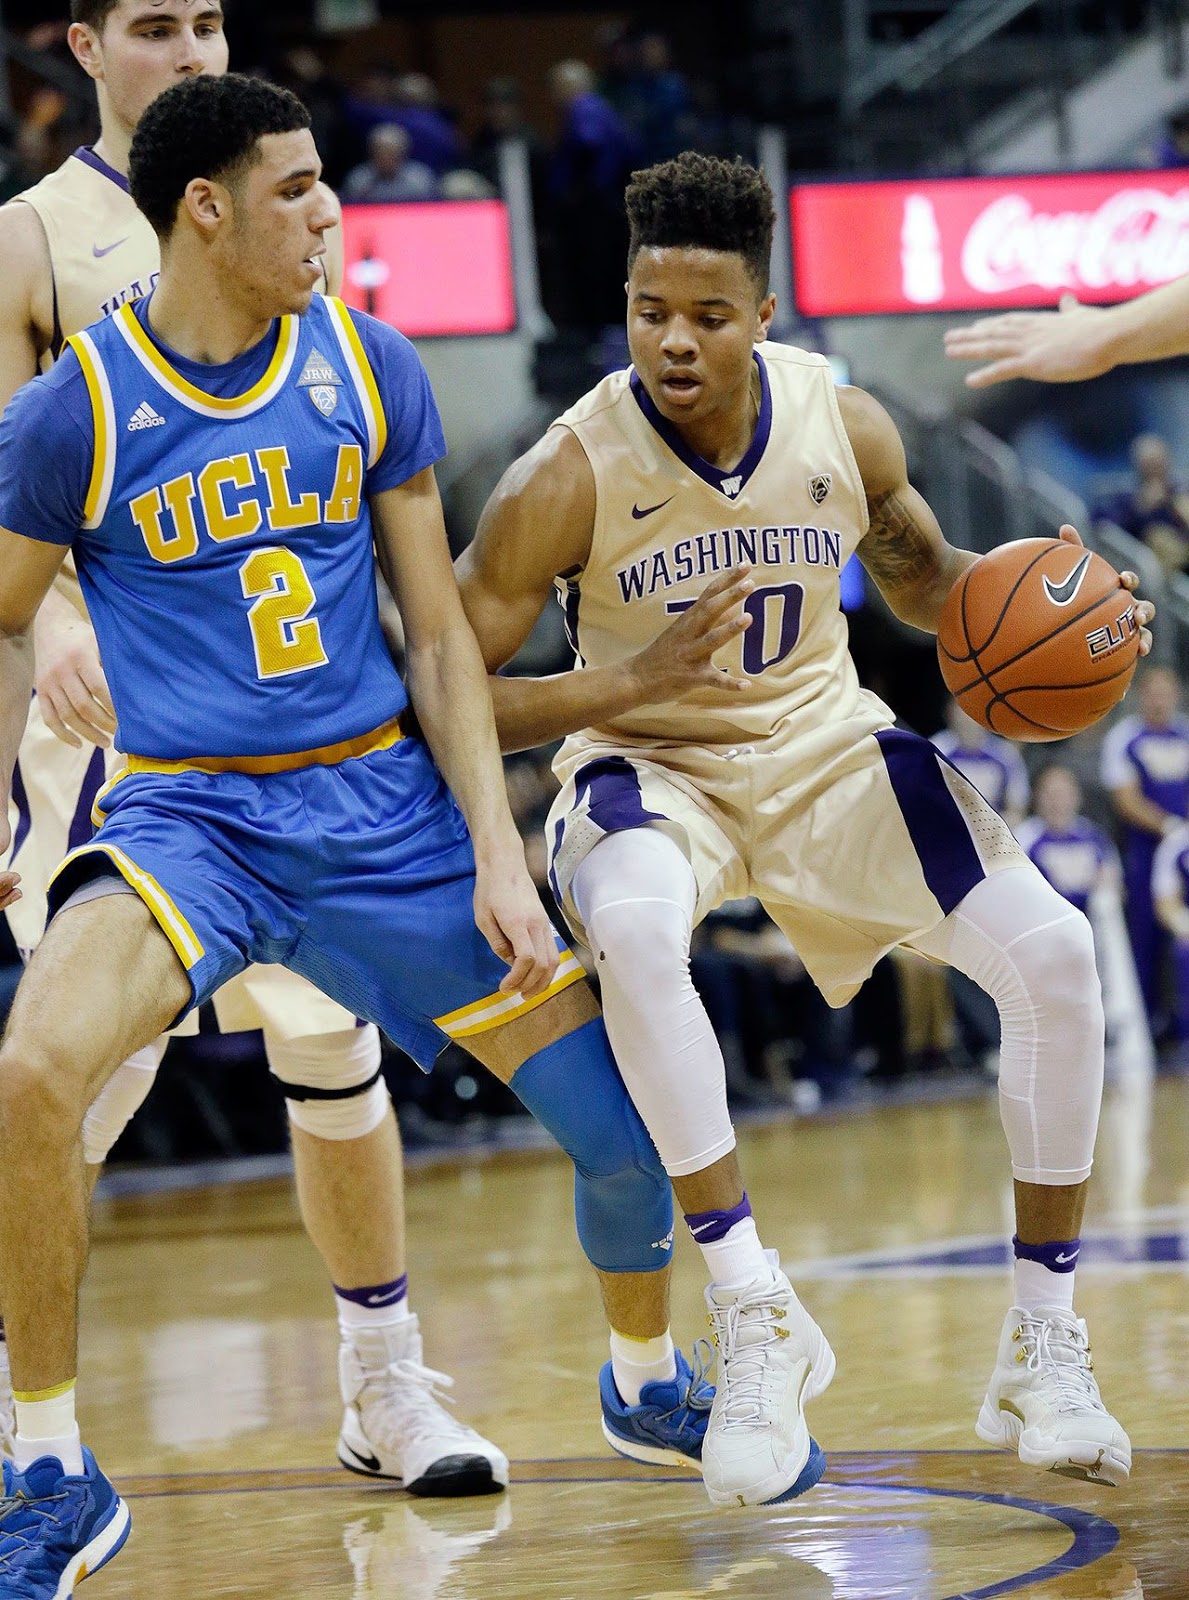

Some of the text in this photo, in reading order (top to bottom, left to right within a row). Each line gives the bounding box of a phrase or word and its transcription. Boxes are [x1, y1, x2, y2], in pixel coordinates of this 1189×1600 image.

[303, 369, 333, 381] JRW
[320, 398, 333, 410] 12
[127, 416, 166, 431] adidas
[720, 475, 743, 496] W
[129, 444, 364, 564] UCLA
[615, 526, 842, 605] WASHINGTON
[239, 545, 330, 680] 2
